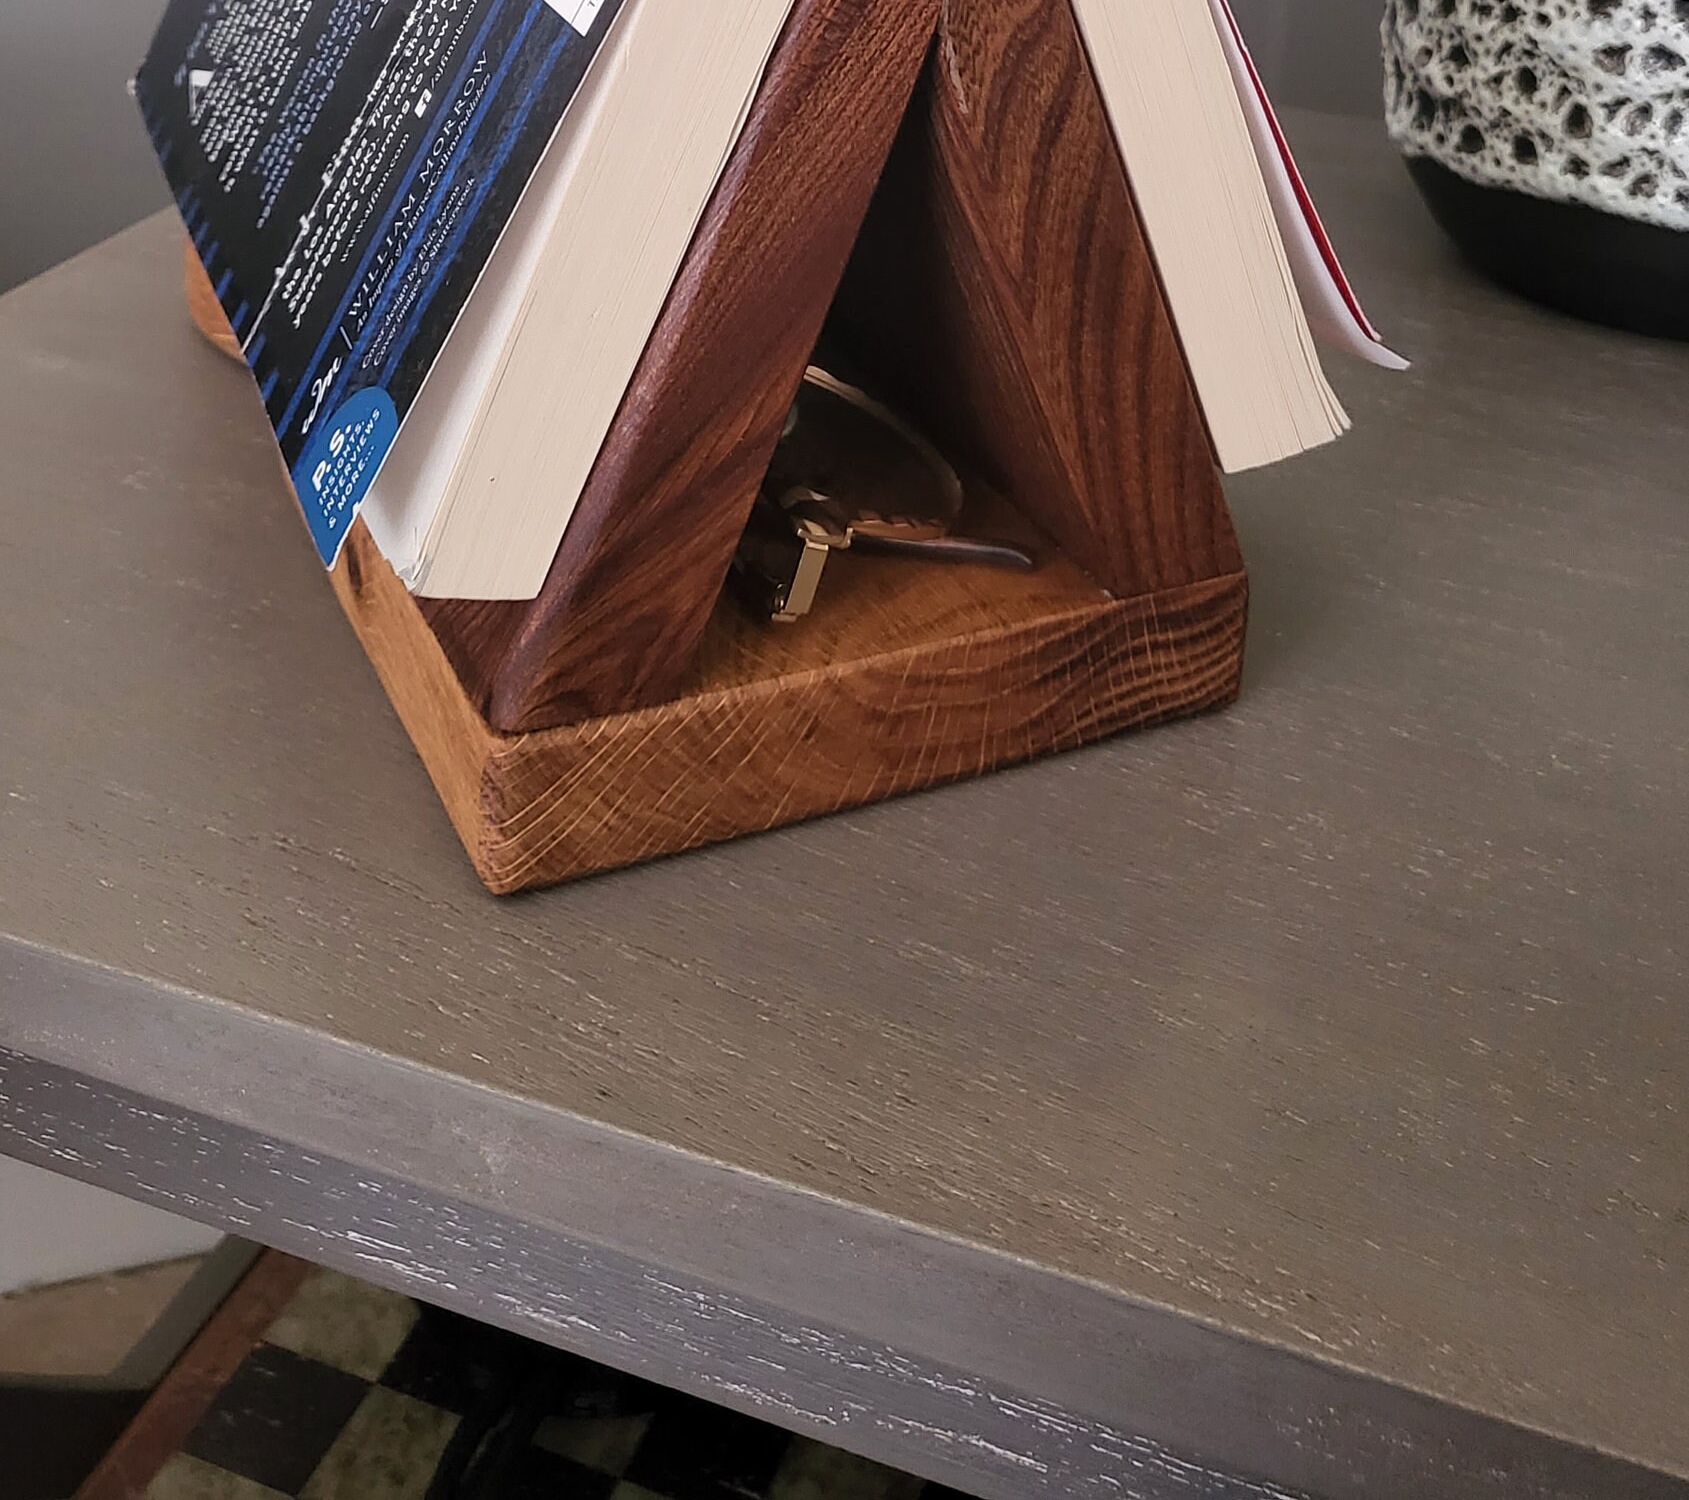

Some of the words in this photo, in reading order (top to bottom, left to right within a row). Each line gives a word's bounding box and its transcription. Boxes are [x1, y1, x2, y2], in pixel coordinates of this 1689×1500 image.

[282, 267, 301, 298] the
[303, 225, 323, 258] Los
[326, 137, 367, 218] Angeles
[368, 69, 403, 126] Times,
[403, 21, 422, 56] the
[288, 191, 350, 312] Supplement
[352, 137, 379, 185] (UK).
[383, 114, 392, 129] A
[393, 44, 425, 105] native
[427, 13, 438, 36] of
[293, 272, 322, 328] years
[321, 199, 358, 266] before
[359, 99, 410, 193] returning
[410, 72, 423, 92] to
[423, 19, 448, 66] New
[340, 133, 409, 261] www.ajfinn.com
[348, 193, 415, 315] WILLIAM
[419, 50, 486, 182] MORROW
[362, 327, 384, 368] Cover
[385, 284, 408, 325] design
[407, 263, 417, 281] by
[418, 228, 436, 260] Elsie
[436, 185, 459, 226] Lyons
[373, 324, 395, 365] Cover
[396, 278, 421, 322] images
[428, 178, 474, 260] Shutterstock
[323, 408, 379, 516] INTERVIEWS
[328, 516, 336, 528] &
[337, 445, 374, 510] MORE...
